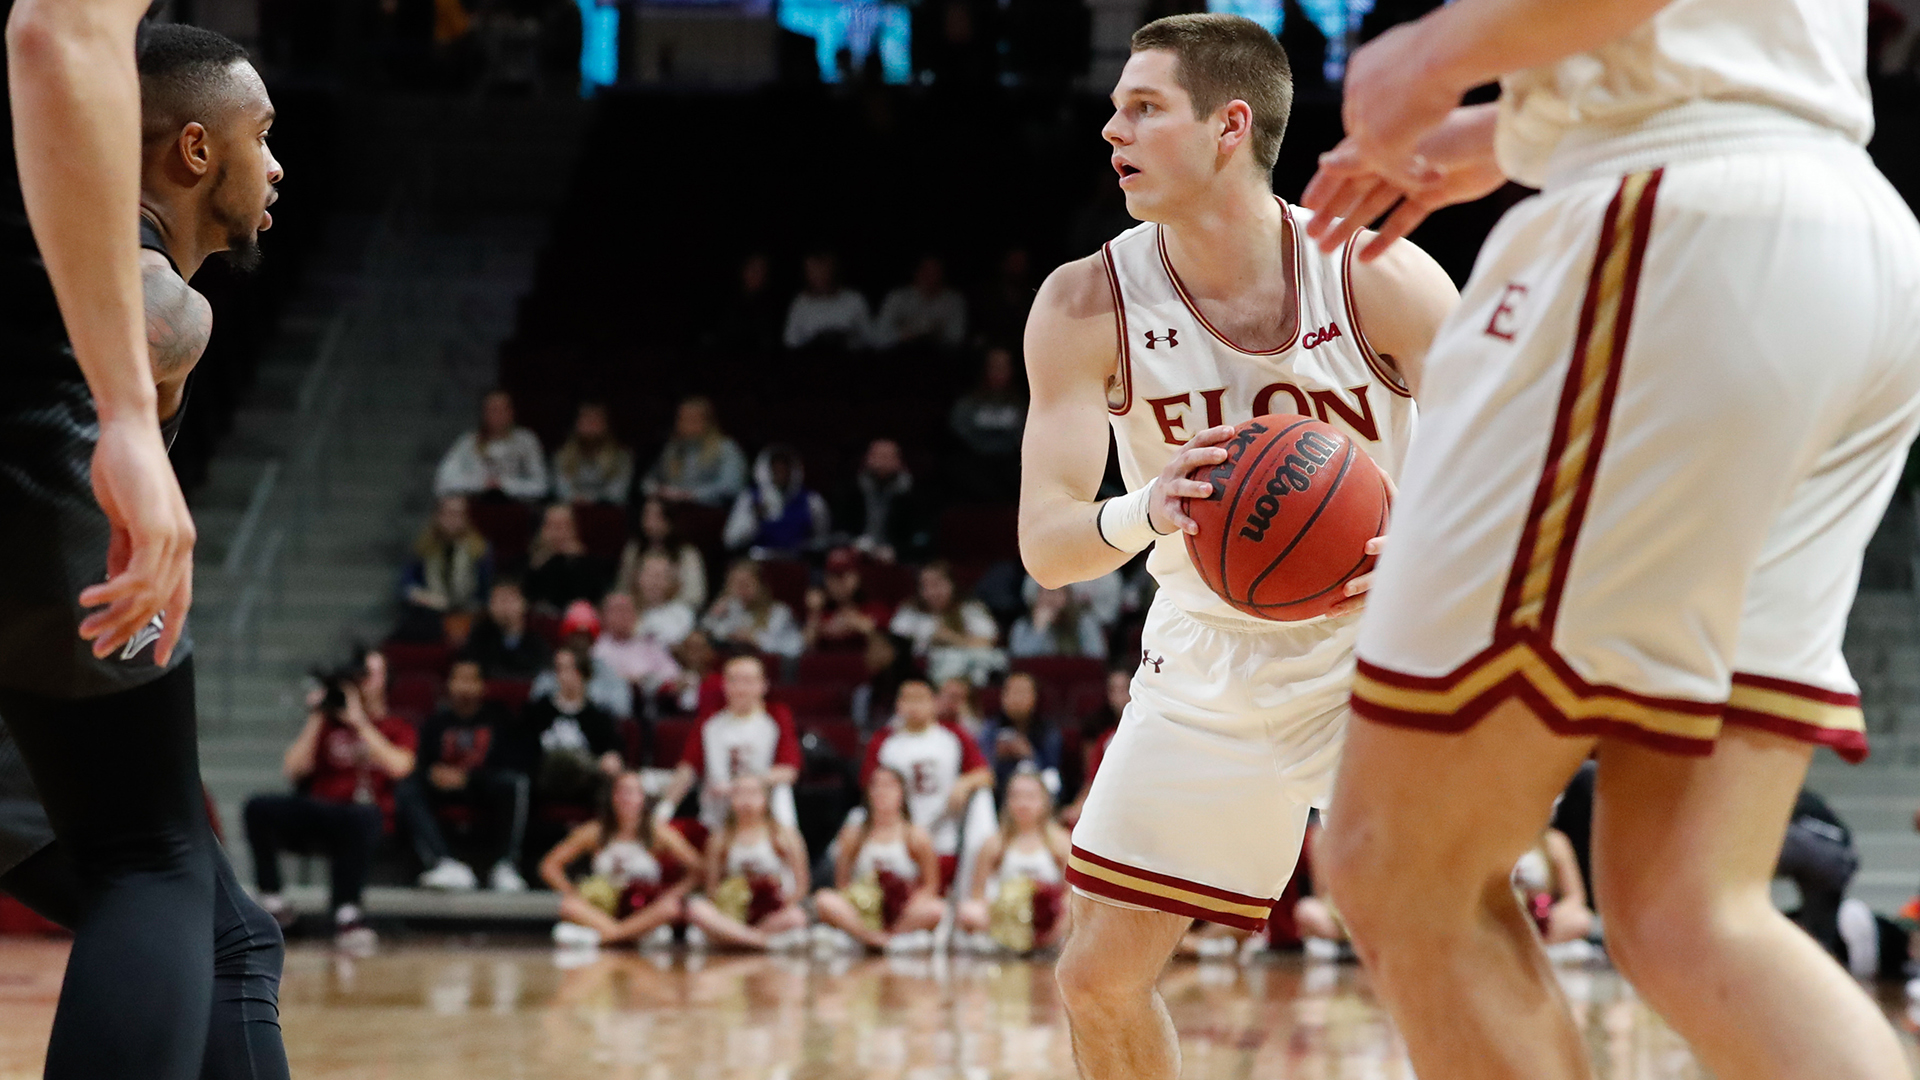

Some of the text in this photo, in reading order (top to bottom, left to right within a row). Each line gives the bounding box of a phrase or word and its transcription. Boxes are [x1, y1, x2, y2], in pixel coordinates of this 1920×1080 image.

[1302, 321, 1342, 350] CAA
[1484, 283, 1528, 343] E
[1238, 430, 1341, 543] Wilson
